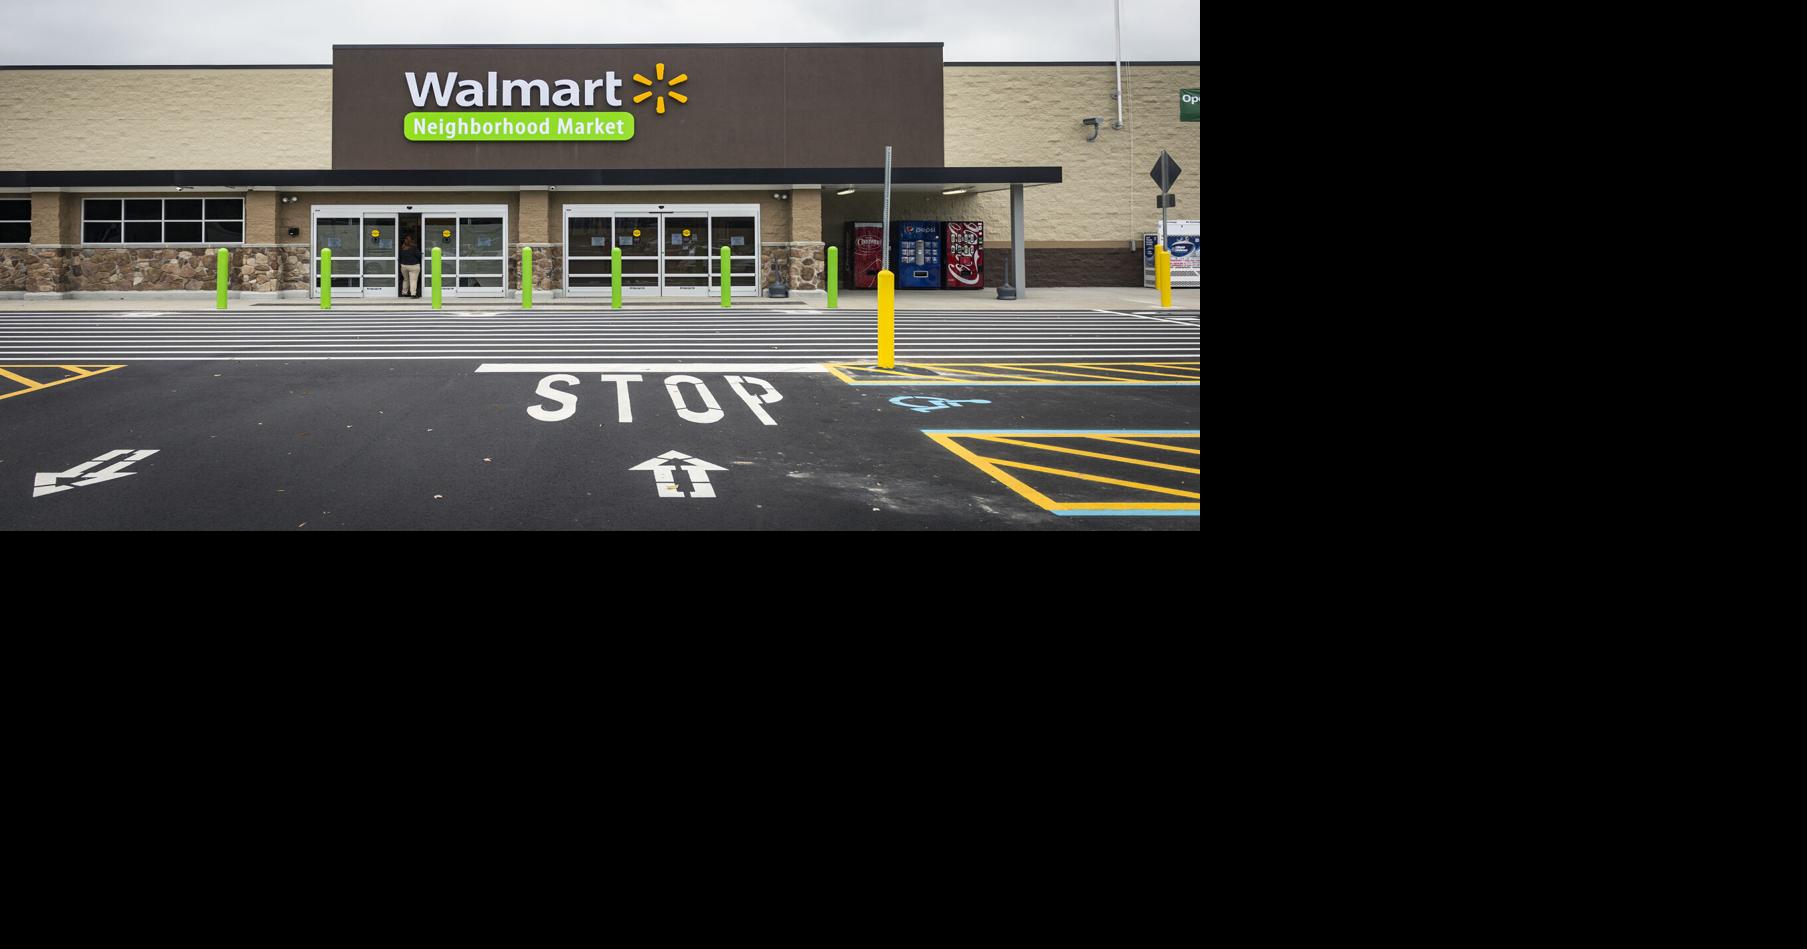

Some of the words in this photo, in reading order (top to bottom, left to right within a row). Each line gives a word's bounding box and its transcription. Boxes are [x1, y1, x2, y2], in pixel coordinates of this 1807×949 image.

[405, 71, 623, 107] Walmart
[1182, 94, 1200, 105] Op
[413, 117, 550, 138] Neighborhood
[557, 117, 624, 135] Market
[526, 373, 784, 426] STOP
